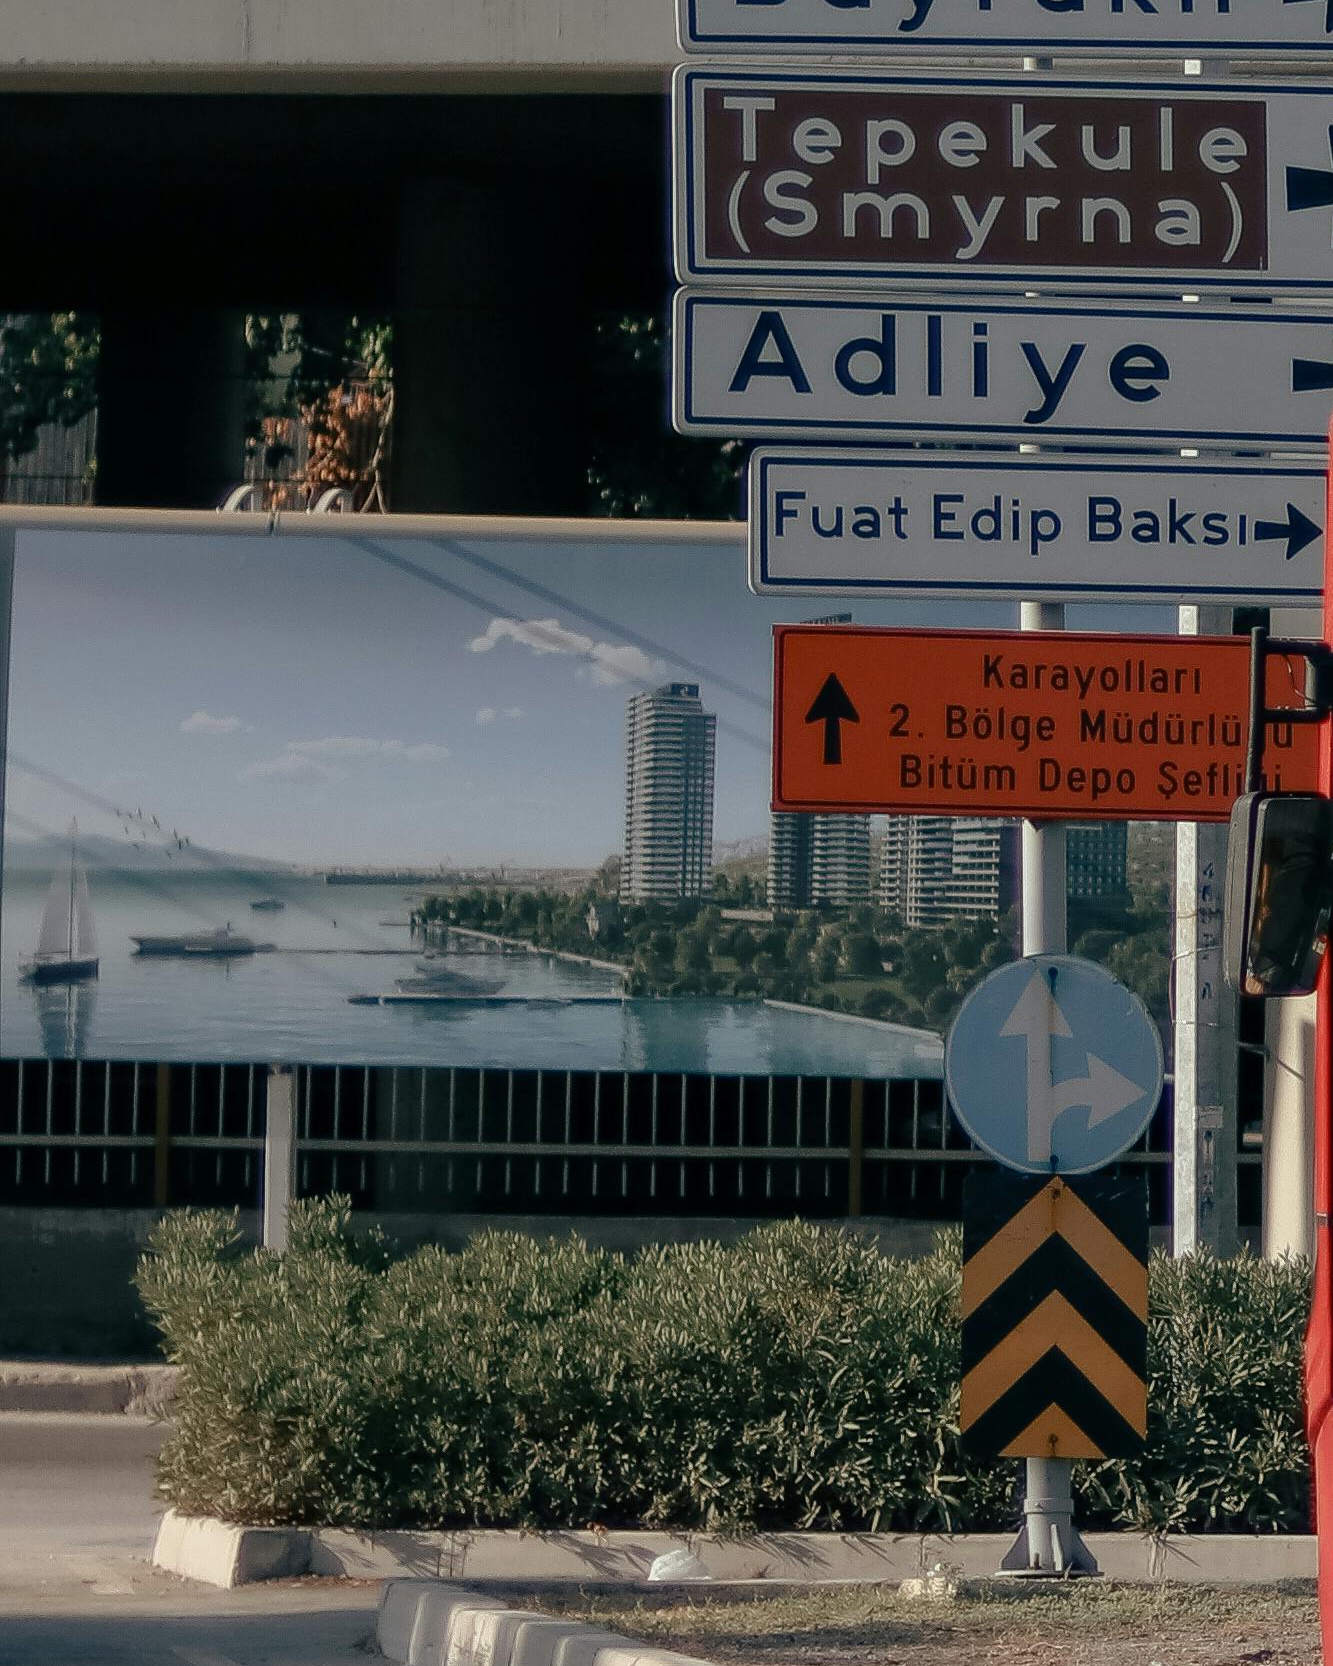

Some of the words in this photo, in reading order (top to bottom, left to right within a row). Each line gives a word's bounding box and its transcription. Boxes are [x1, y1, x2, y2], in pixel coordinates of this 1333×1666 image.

[723, 95, 1248, 184] Tepekule
[728, 170, 1245, 264] (Smyrna)
[727, 310, 1172, 424] Adliye
[773, 491, 910, 540] Fuat
[932, 493, 1062, 556] Edip
[1087, 496, 1247, 546] Baksı
[983, 654, 1202, 699] Karayolları
[889, 704, 926, 739] 2.
[945, 706, 1056, 750] Bölge
[1079, 710, 1294, 749] Müdürlüü
[899, 754, 1016, 792] Bitüm
[1039, 760, 1136, 801] Depo
[1157, 763, 1283, 797] Şeflii
